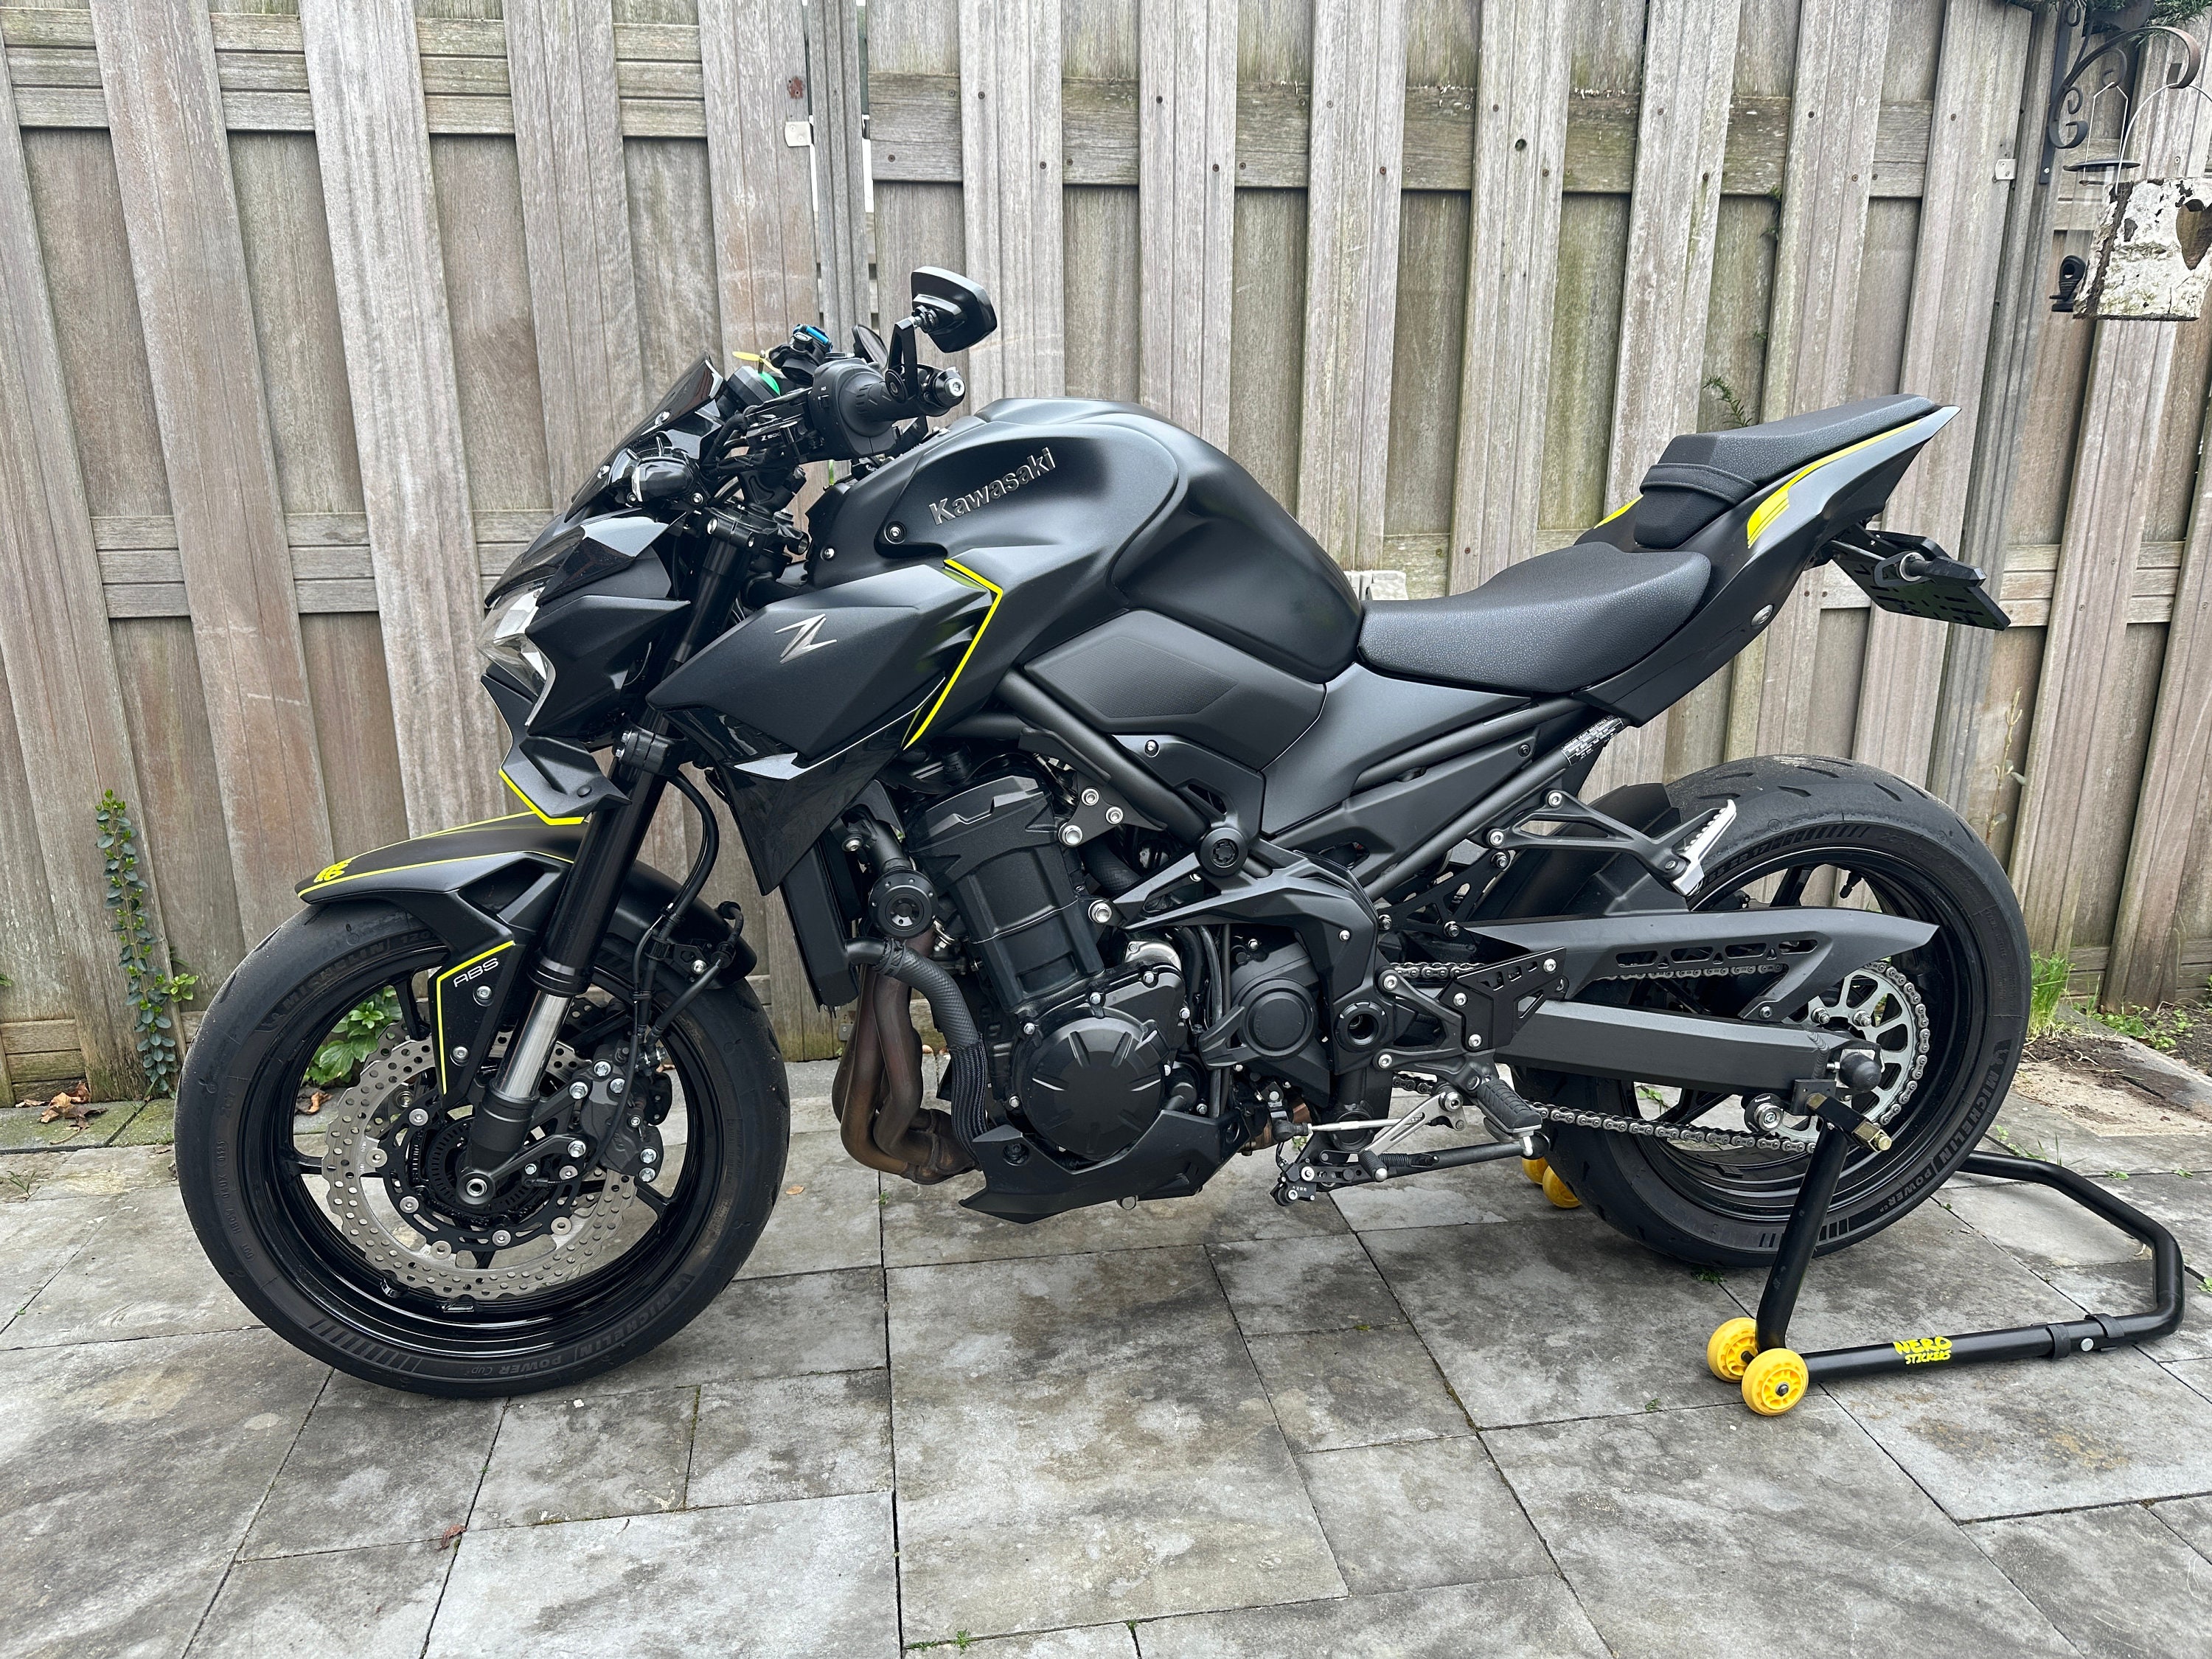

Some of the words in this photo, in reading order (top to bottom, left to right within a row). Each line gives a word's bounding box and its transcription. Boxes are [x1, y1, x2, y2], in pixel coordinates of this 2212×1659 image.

[929, 447, 1056, 525] Kawasaki
[282, 940, 386, 1011] MICHELIN
[453, 958, 499, 987] ABS
[1939, 1070, 2000, 1164] MICHELIN
[1889, 1168, 1932, 1206] POWER
[579, 1286, 672, 1359] MICHELIN
[1893, 1336, 1952, 1354] NERO
[1905, 1349, 1952, 1364] STICKERS
[499, 1354, 563, 1376] POWER
